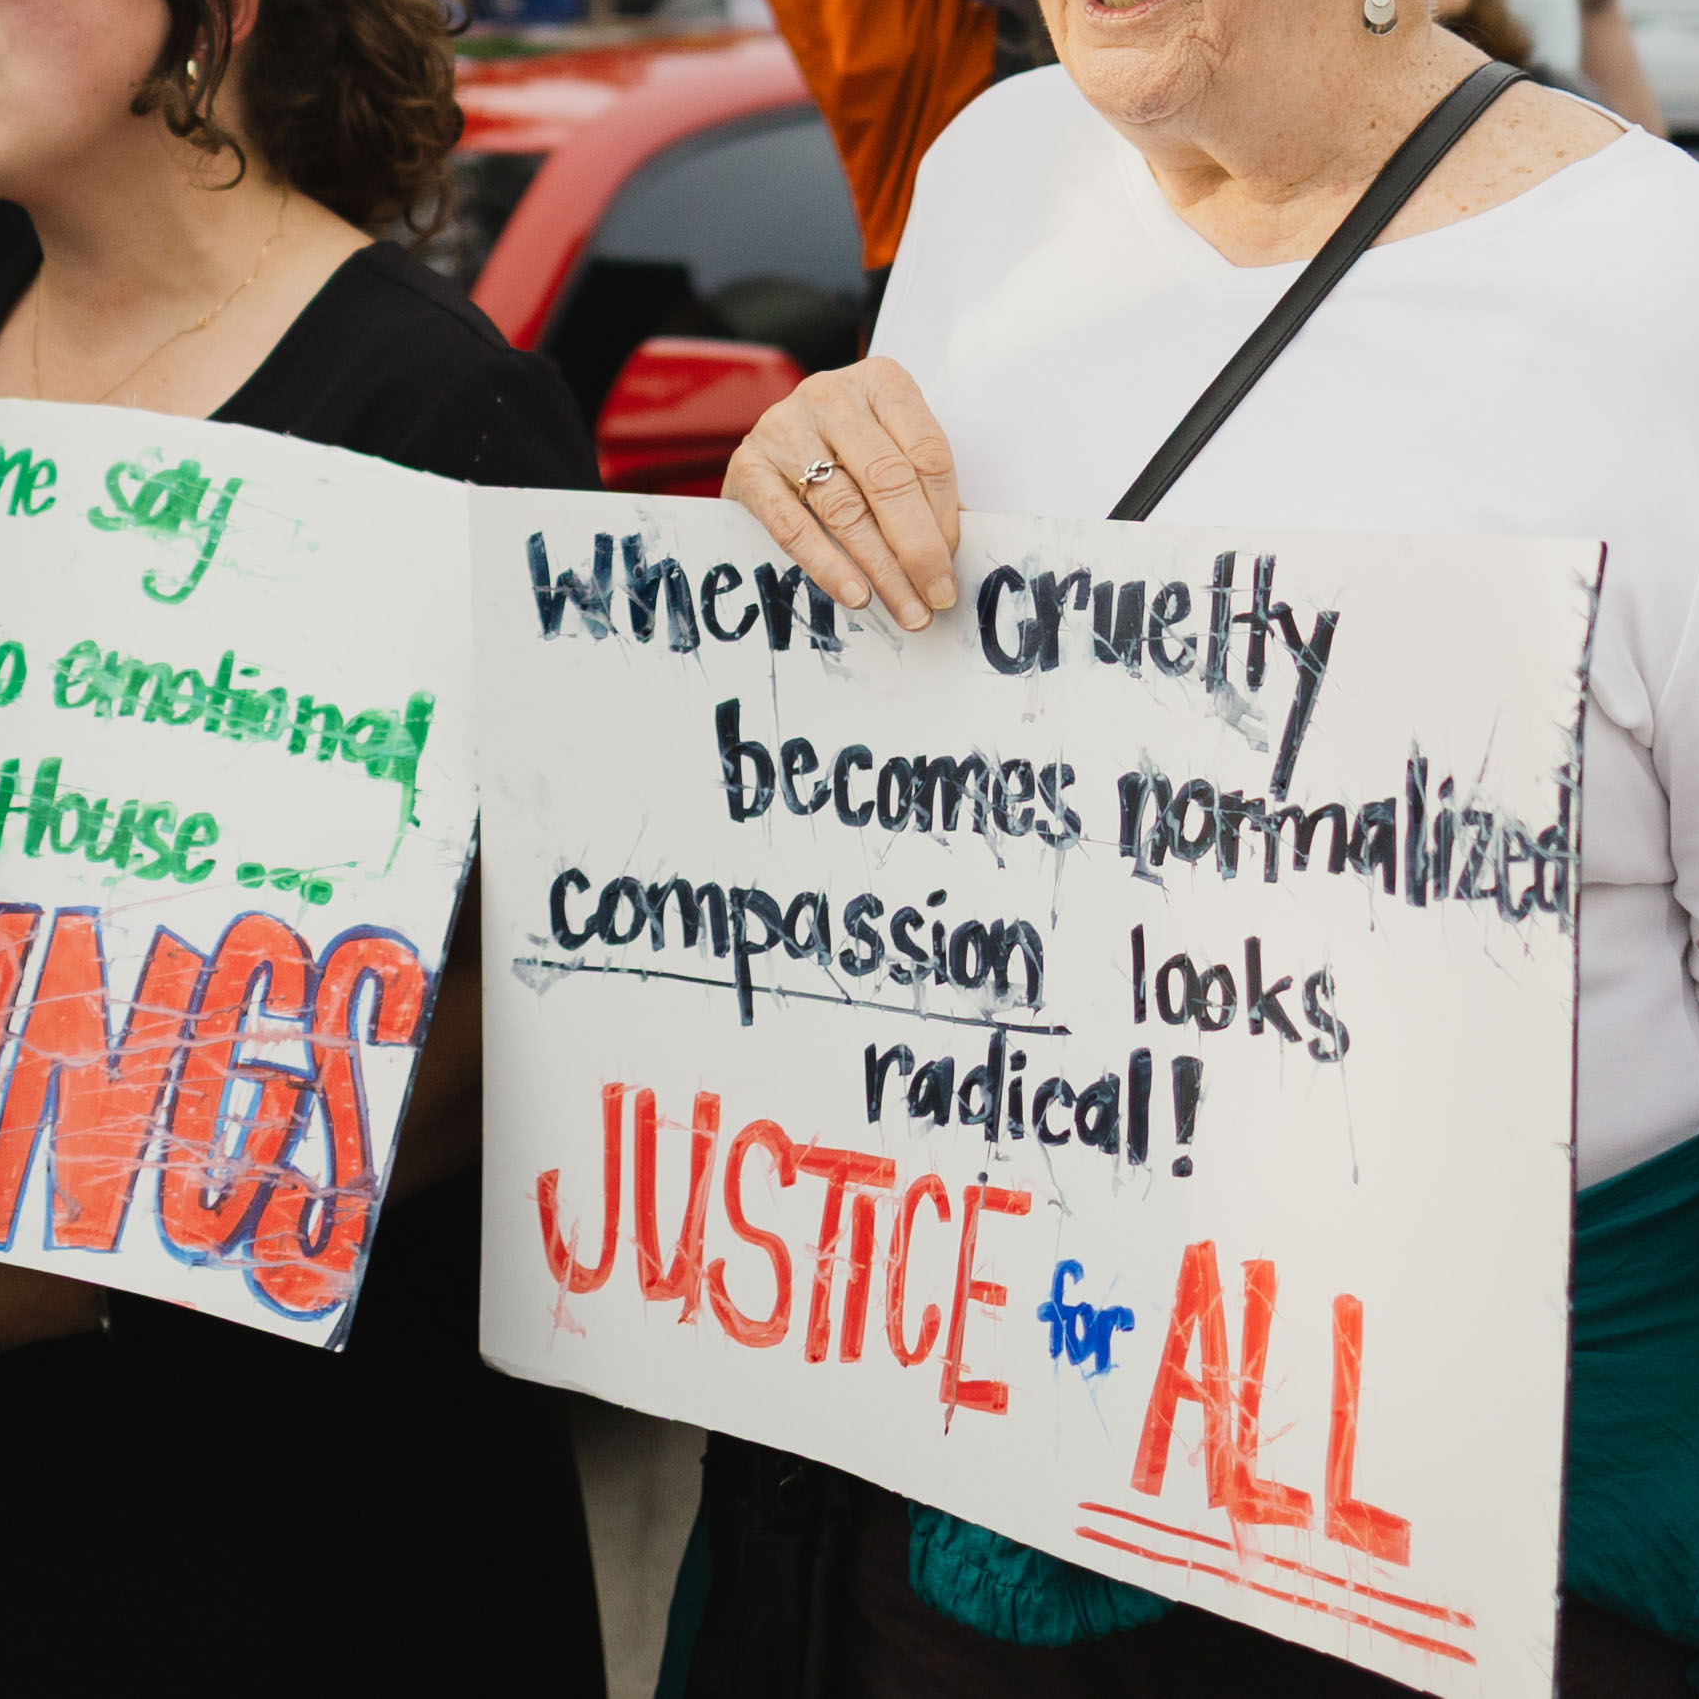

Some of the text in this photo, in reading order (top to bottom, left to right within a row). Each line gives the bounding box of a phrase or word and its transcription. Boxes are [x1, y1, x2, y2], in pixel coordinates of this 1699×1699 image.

[87, 450, 242, 604] say
[52, 639, 435, 785] emotional
[977, 550, 1340, 801] cruelty
[714, 697, 1575, 924] becomes normalized
[549, 868, 1352, 1064] compassion looks
[863, 1030, 1205, 1177] radical!
[534, 1083, 1413, 1568] JUSTICE for ALL
